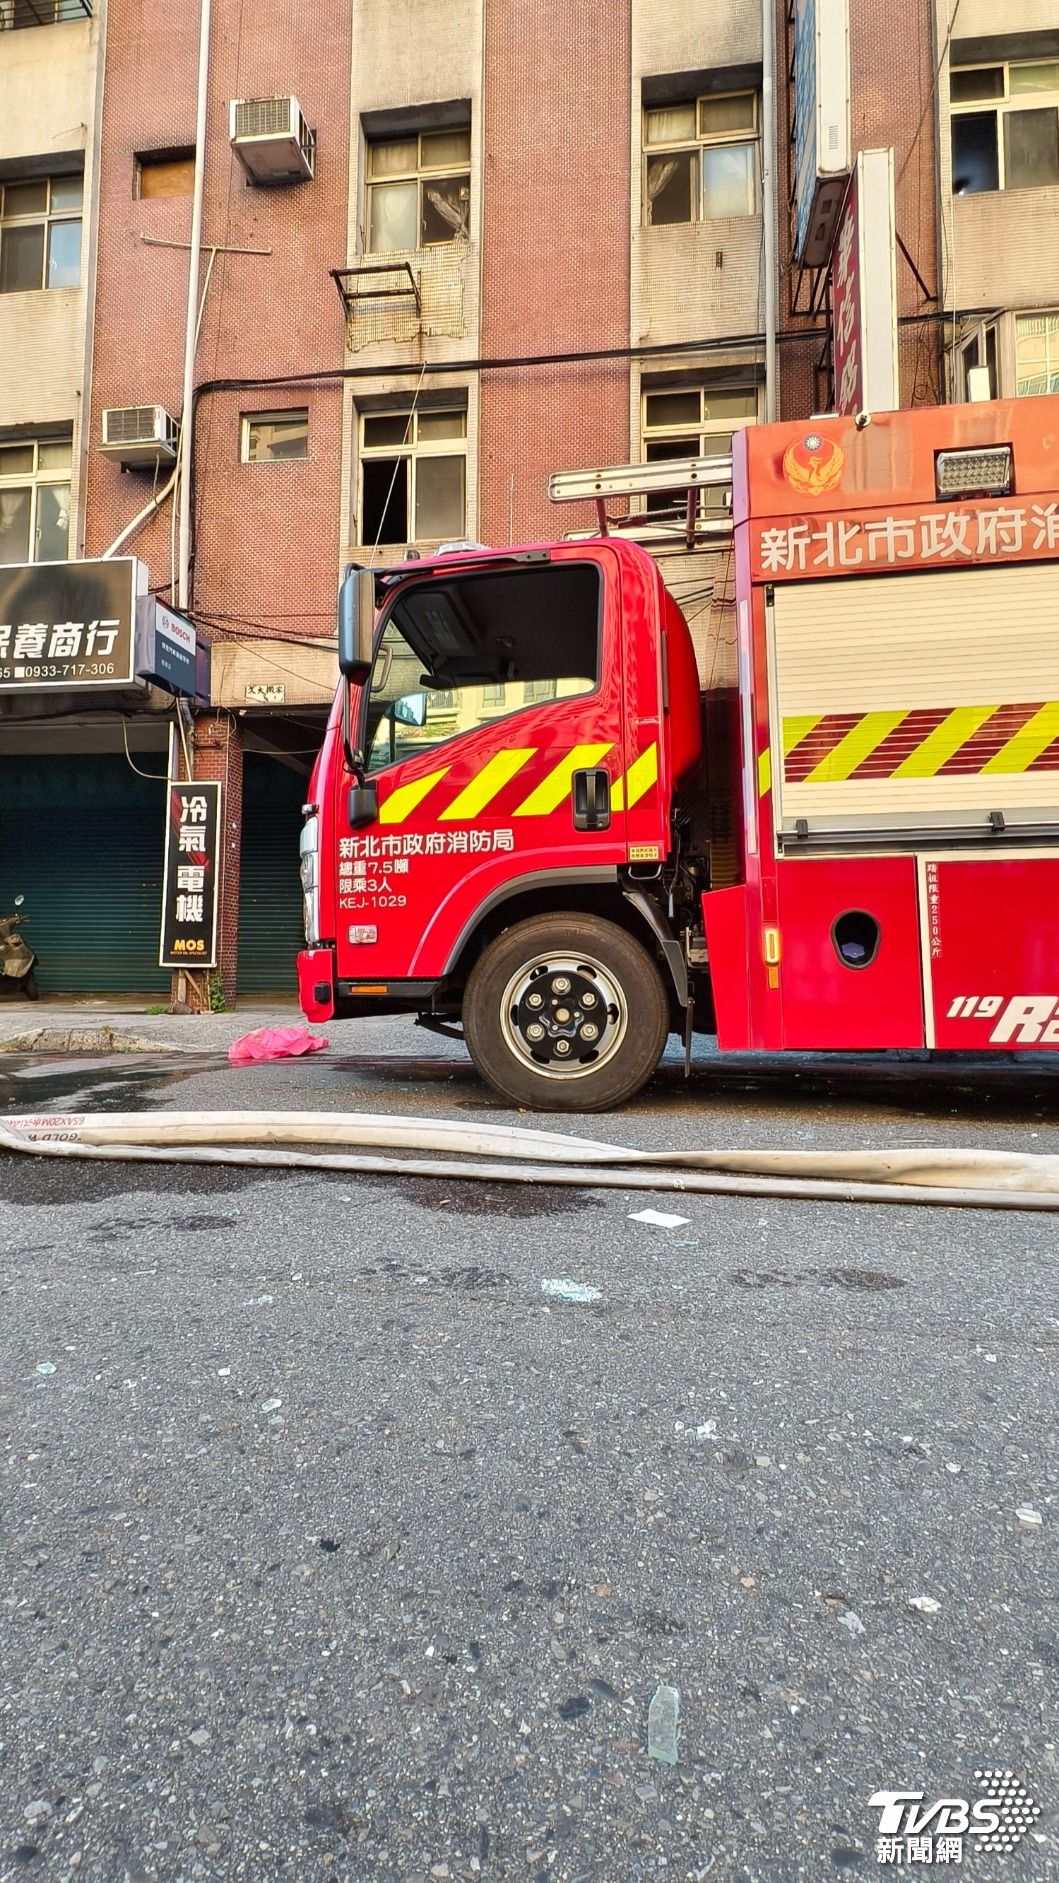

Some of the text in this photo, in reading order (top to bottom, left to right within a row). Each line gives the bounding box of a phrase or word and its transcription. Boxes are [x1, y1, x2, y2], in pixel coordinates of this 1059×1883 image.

[760, 503, 1059, 573] 新北市政府消
[171, 623, 191, 644] BOSCH
[25, 662, 114, 678] 0933-717-306
[339, 828, 514, 858] 新北市政府消防局
[339, 858, 409, 877] 總重7.5噸
[339, 877, 392, 895] 限乘3人
[339, 895, 407, 909] KEJ-1029
[173, 939, 205, 951] MOS
[946, 996, 1004, 1018] 119
